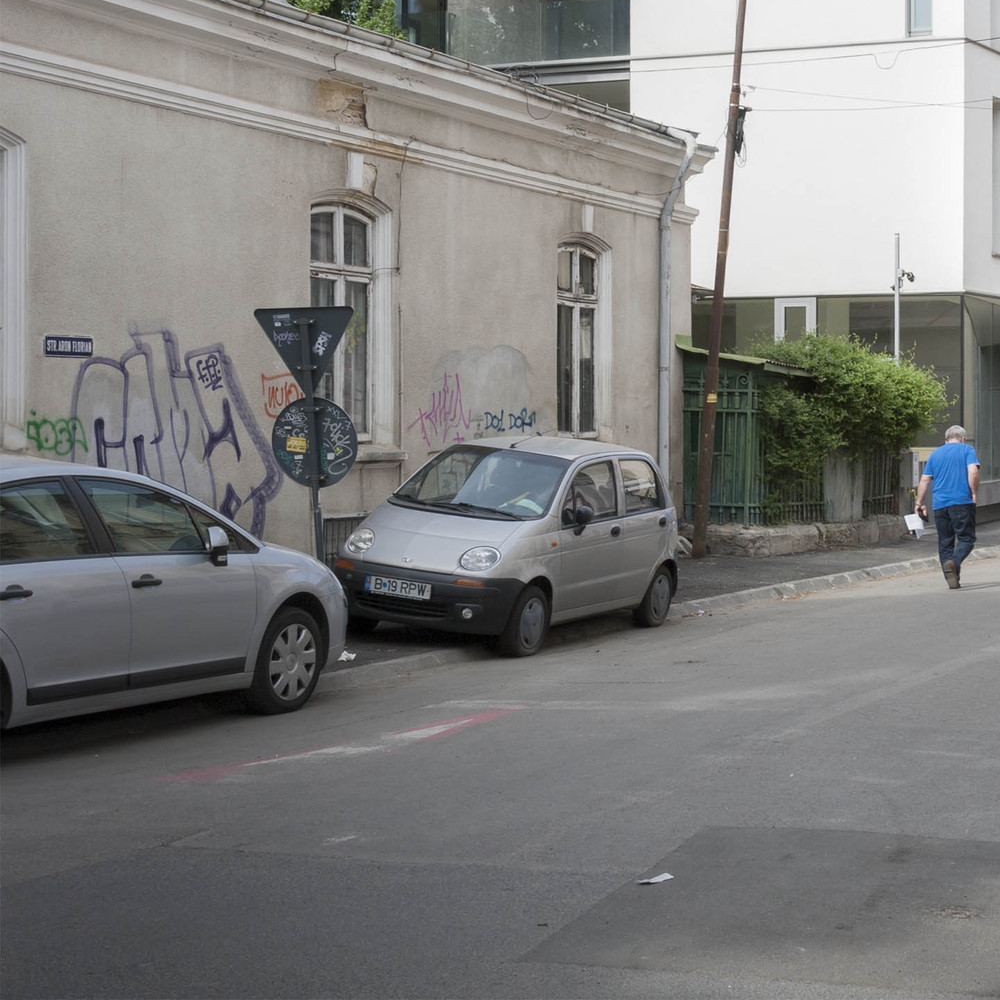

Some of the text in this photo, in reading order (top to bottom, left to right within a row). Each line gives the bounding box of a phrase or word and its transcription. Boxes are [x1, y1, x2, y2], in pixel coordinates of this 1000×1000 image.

[72, 341, 92, 353] FLORIAN
[374, 578, 427, 597] B 19 RPW
